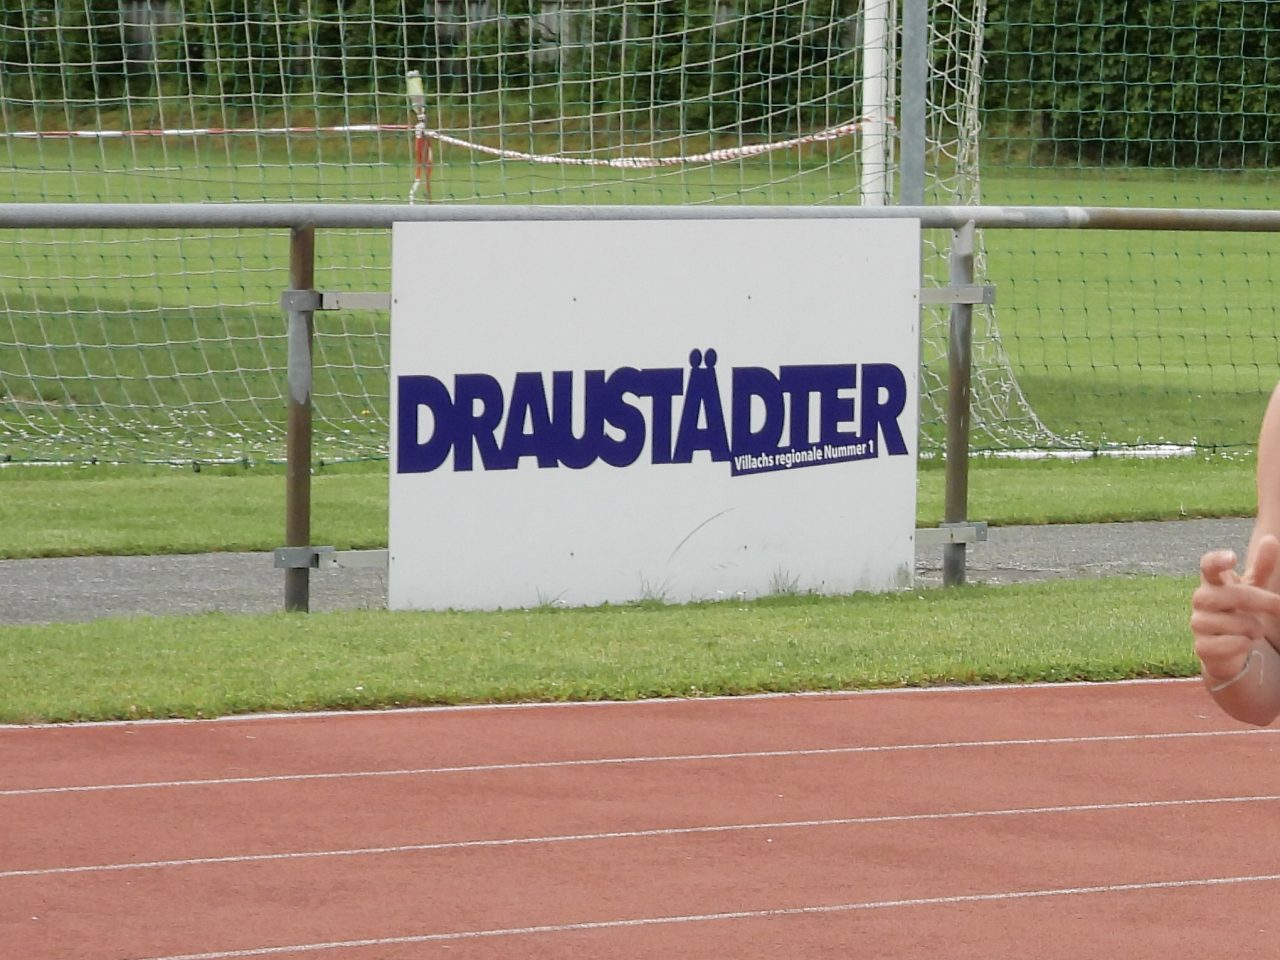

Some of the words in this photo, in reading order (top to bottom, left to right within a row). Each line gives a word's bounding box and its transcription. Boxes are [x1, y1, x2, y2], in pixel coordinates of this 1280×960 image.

[397, 348, 909, 474] DRAUSTÄDTER
[734, 451, 774, 471] Villachs
[775, 446, 823, 468] regionale
[823, 442, 867, 459] Nummer
[867, 439, 874, 454] 1
